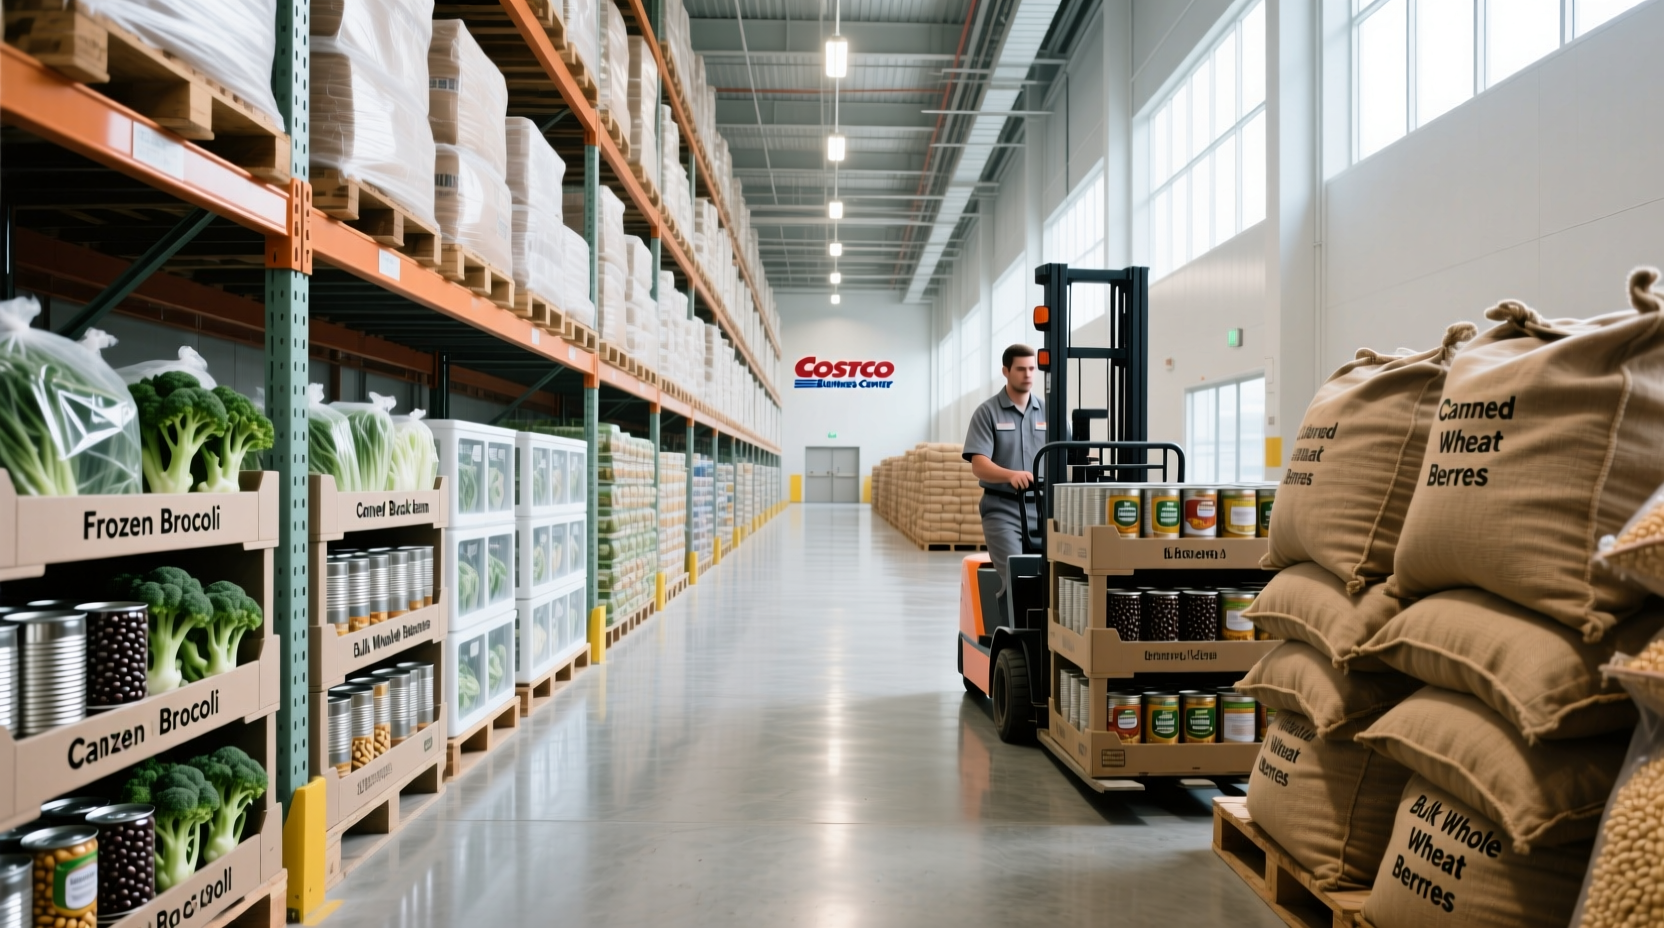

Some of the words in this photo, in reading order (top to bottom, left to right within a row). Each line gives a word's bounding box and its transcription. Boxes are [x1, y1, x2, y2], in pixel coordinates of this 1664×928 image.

[794, 356, 895, 378] COSTCO
[1439, 396, 1516, 421] Canned
[1440, 429, 1504, 453] Wheat
[1427, 464, 1488, 487] Berres
[84, 511, 153, 540] Frozen
[161, 505, 221, 535] Brocoli
[67, 724, 145, 770] Canzen
[159, 689, 219, 735] Brocoli
[1409, 794, 1443, 826] Bulk
[1441, 809, 1502, 858] Whole
[1408, 826, 1467, 880] Wheat
